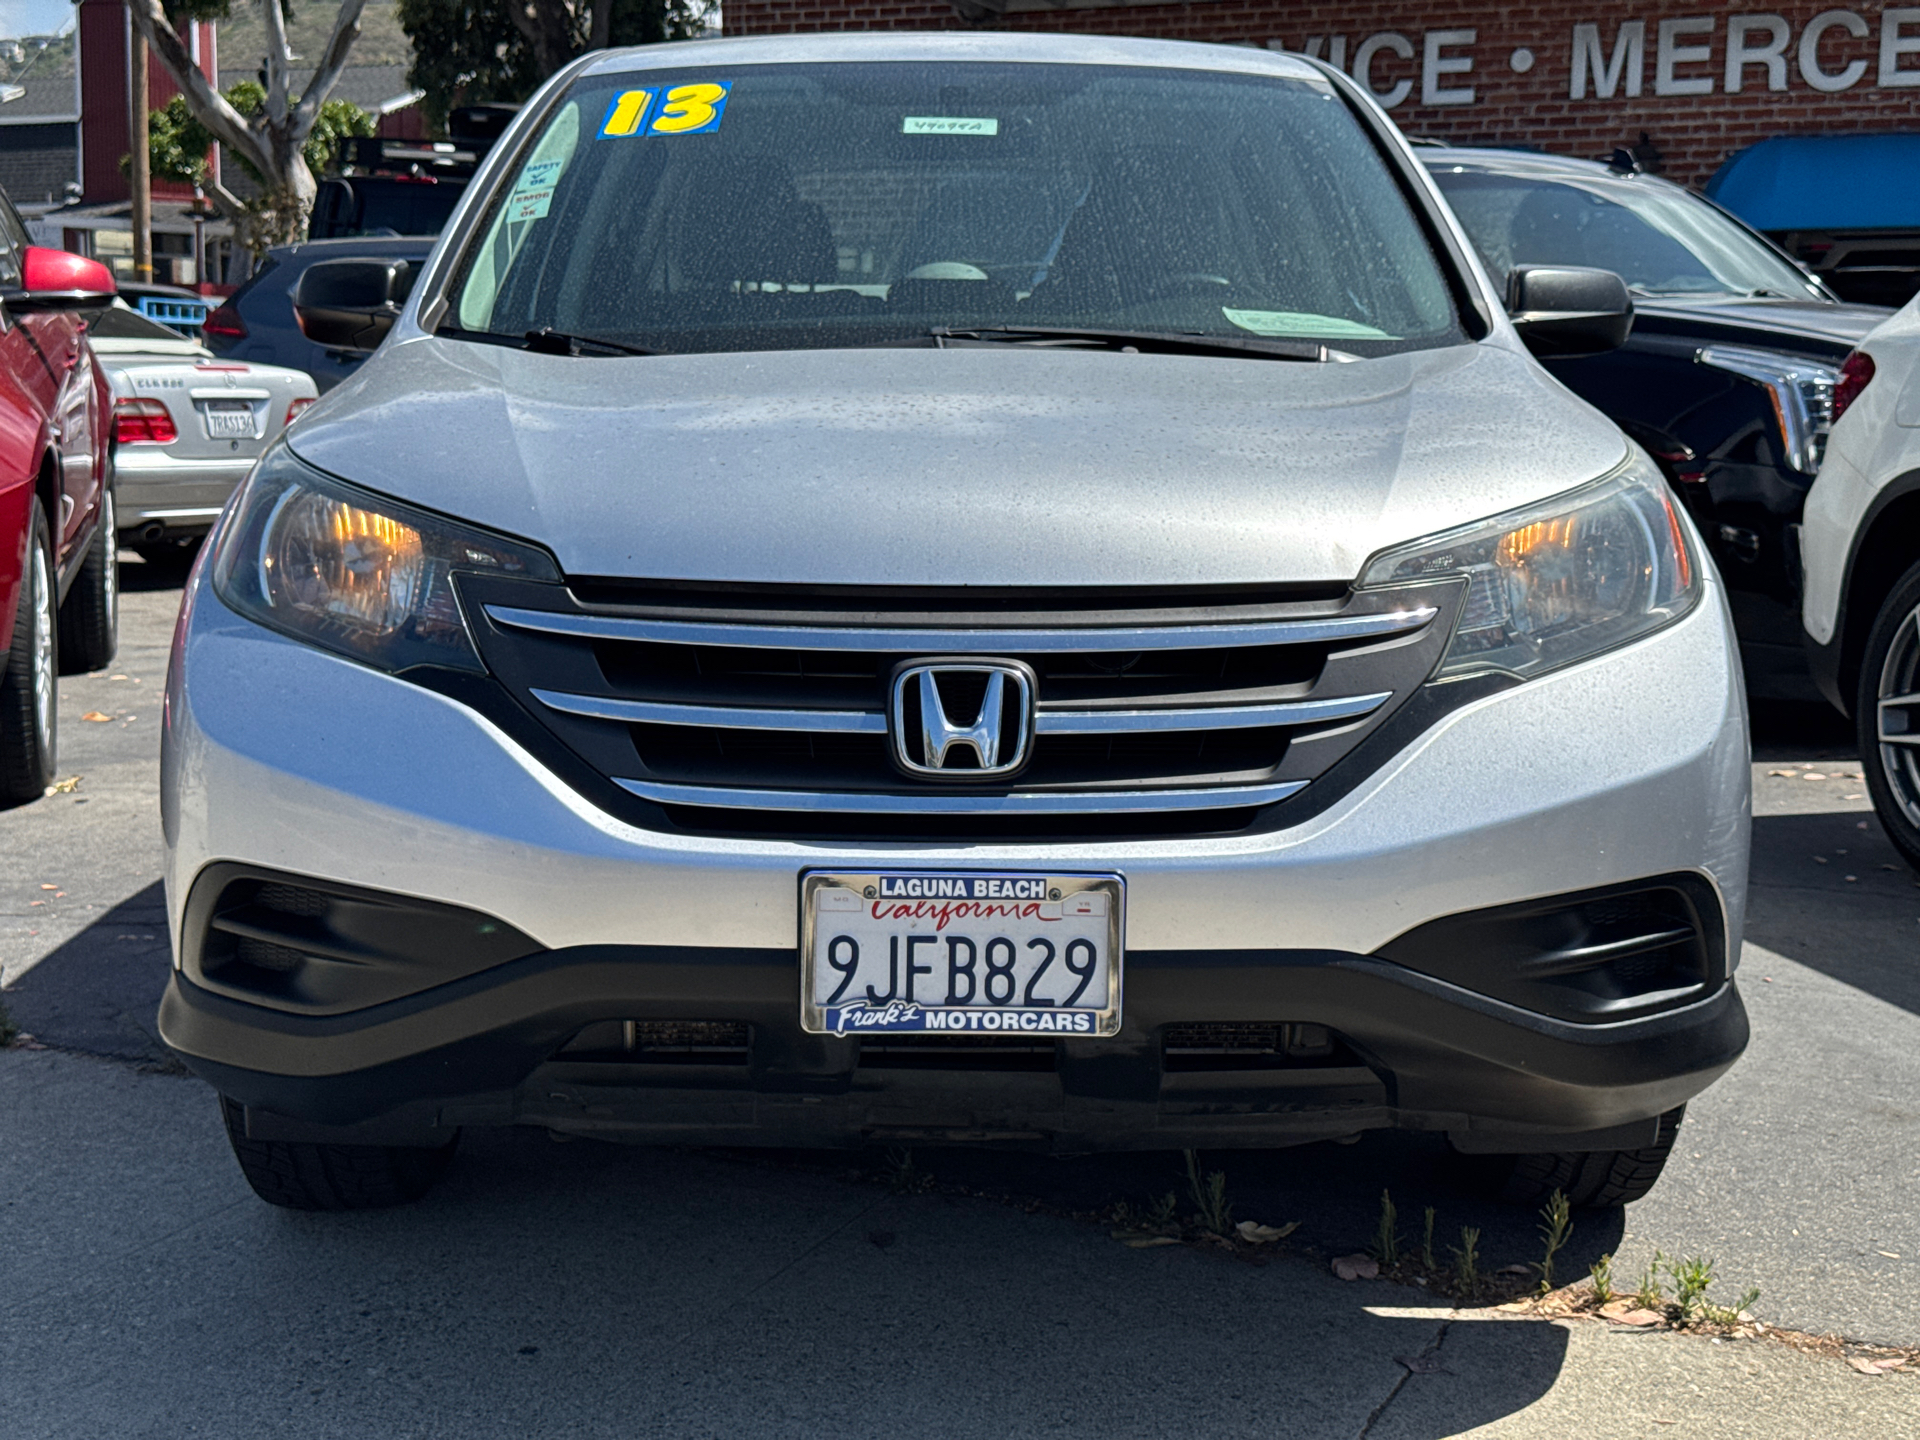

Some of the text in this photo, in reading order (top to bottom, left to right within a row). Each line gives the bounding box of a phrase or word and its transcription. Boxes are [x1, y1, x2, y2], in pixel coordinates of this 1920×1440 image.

[603, 83, 727, 136] 13
[529, 178, 546, 187] OK
[515, 191, 550, 204] SMOG
[520, 209, 536, 218] OK
[881, 879, 1045, 899] LAGUNA BEACH
[871, 900, 1062, 932] California
[826, 934, 1098, 1008] 9JFB829
[836, 1002, 1091, 1033] Frank's MOTORCARS
